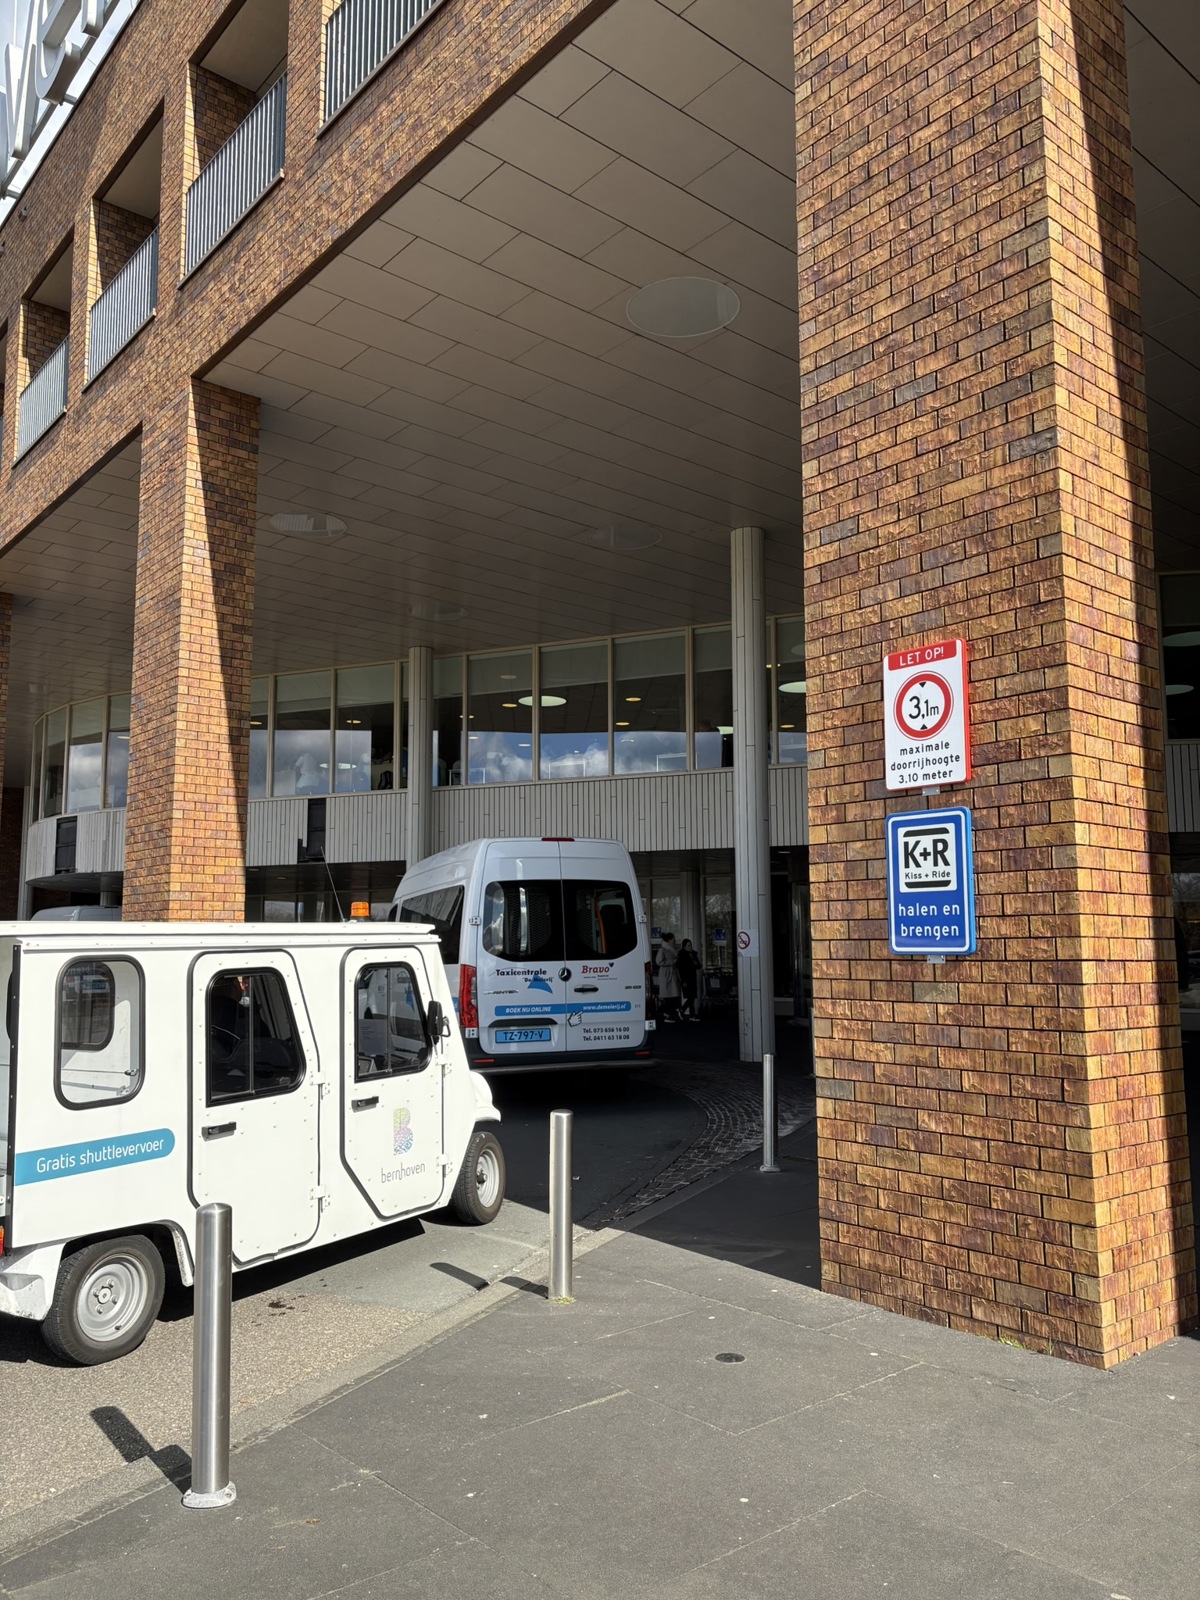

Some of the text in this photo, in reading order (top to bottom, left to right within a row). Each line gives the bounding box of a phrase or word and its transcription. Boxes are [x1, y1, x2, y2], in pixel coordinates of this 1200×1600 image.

[899, 646, 944, 666] LET OP!
[908, 695, 939, 719] 3,1m
[900, 740, 950, 756] maximale
[890, 753, 960, 771] doorrijhoogte
[898, 769, 953, 784] 3.10 meter
[903, 838, 950, 869] K+R
[904, 872, 922, 880] Kiss
[932, 870, 951, 878] Ride
[898, 902, 960, 917] halen en
[901, 923, 959, 940] brengen
[495, 968, 547, 976] Taxicentrale
[581, 965, 610, 974] Bravo
[503, 1030, 544, 1041] TZ-797-V
[36, 1139, 164, 1173] Gratis shuttlevervoer
[381, 1162, 425, 1184] bernhoven
